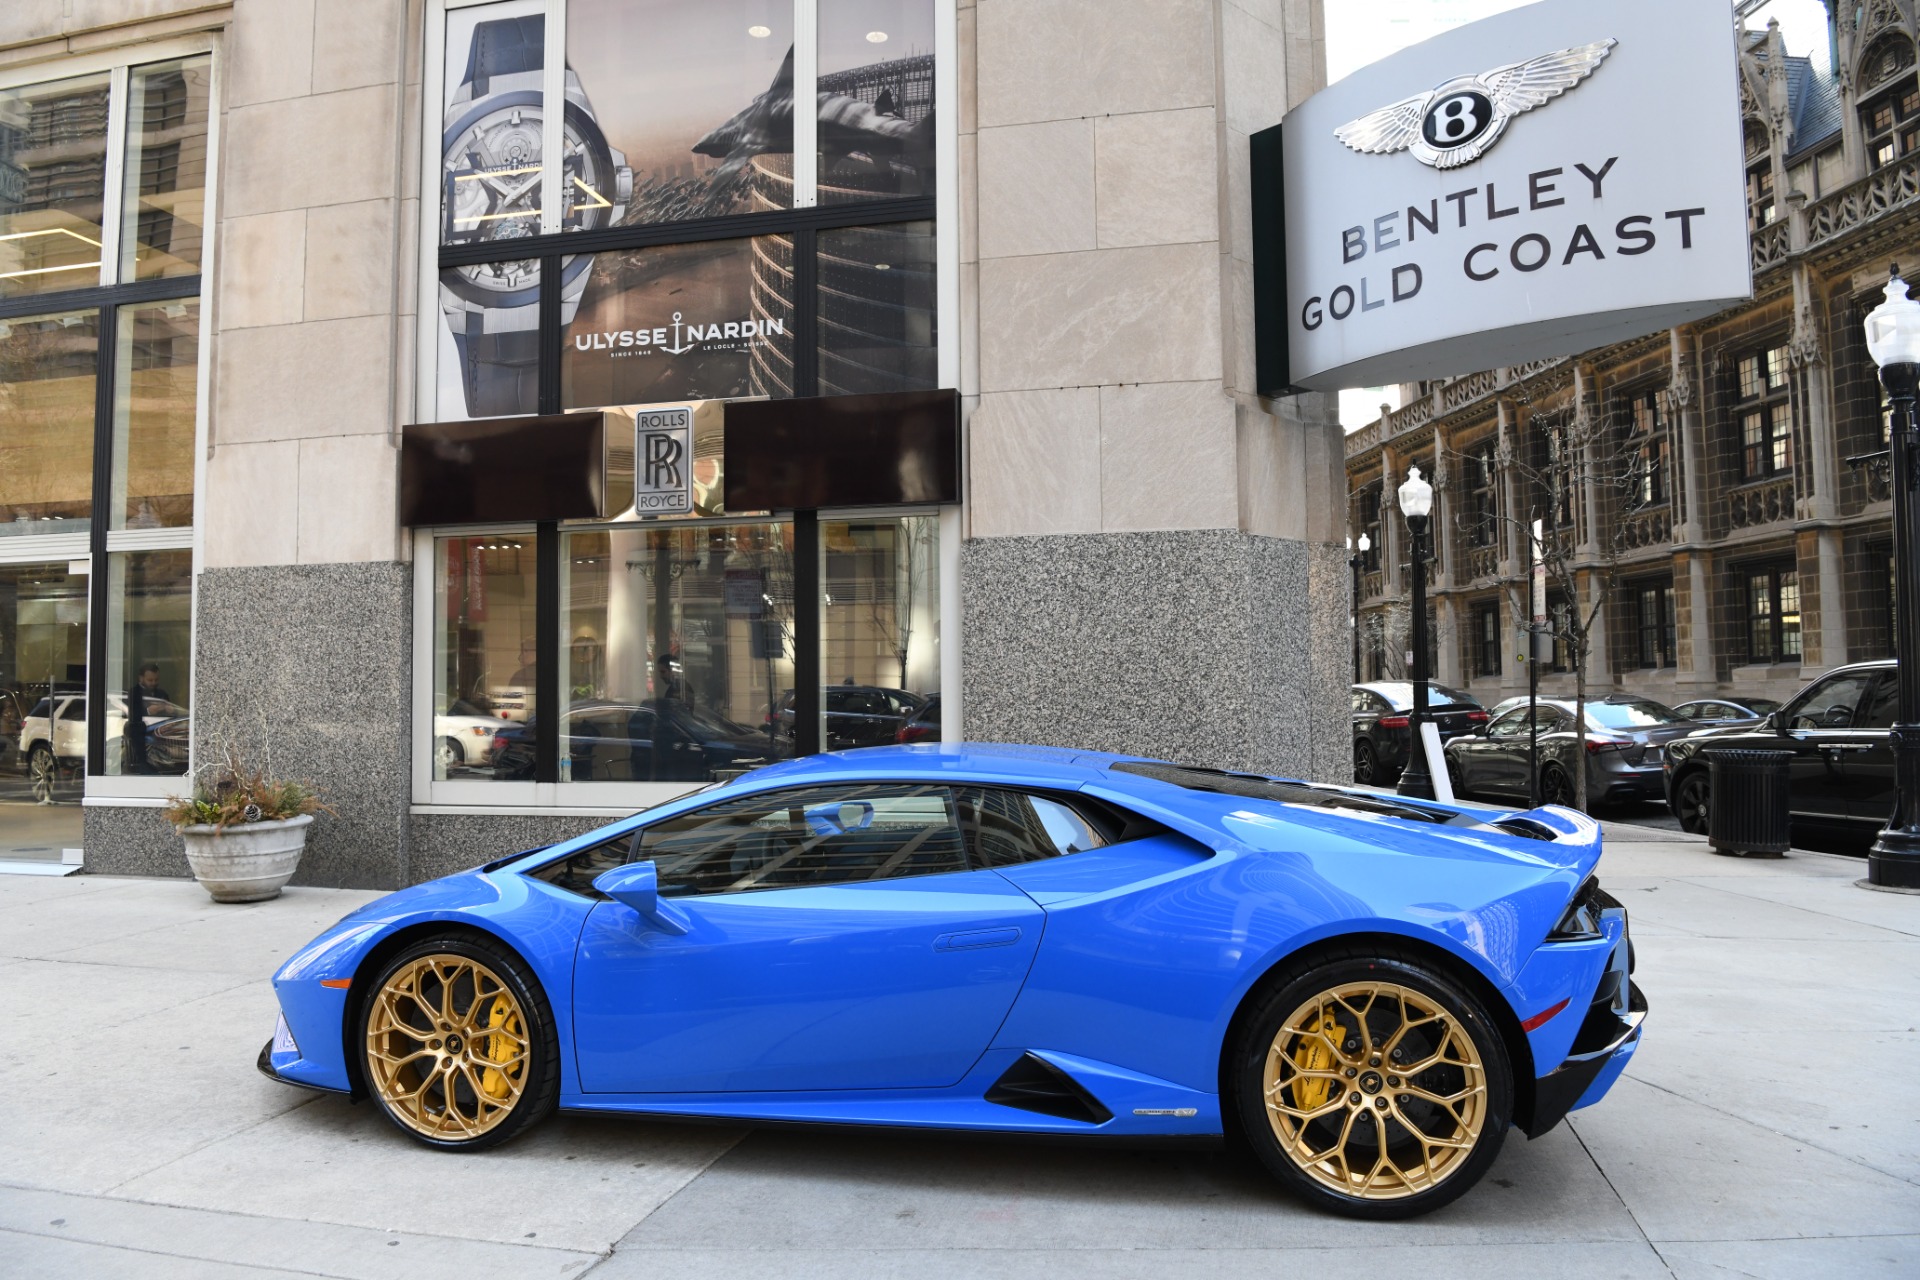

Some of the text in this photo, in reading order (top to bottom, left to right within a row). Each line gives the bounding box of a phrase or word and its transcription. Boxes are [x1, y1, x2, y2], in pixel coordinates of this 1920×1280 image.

[1433, 96, 1477, 142] B
[518, 162, 542, 170] NARDI
[1342, 156, 1618, 265] BENTLEY
[1302, 207, 1705, 331] GOLD COAST
[576, 318, 783, 350] ULYSSE NARDIN
[611, 350, 632, 358] SINCE
[641, 413, 685, 428] ROLLS
[640, 494, 685, 508] ROYCE
